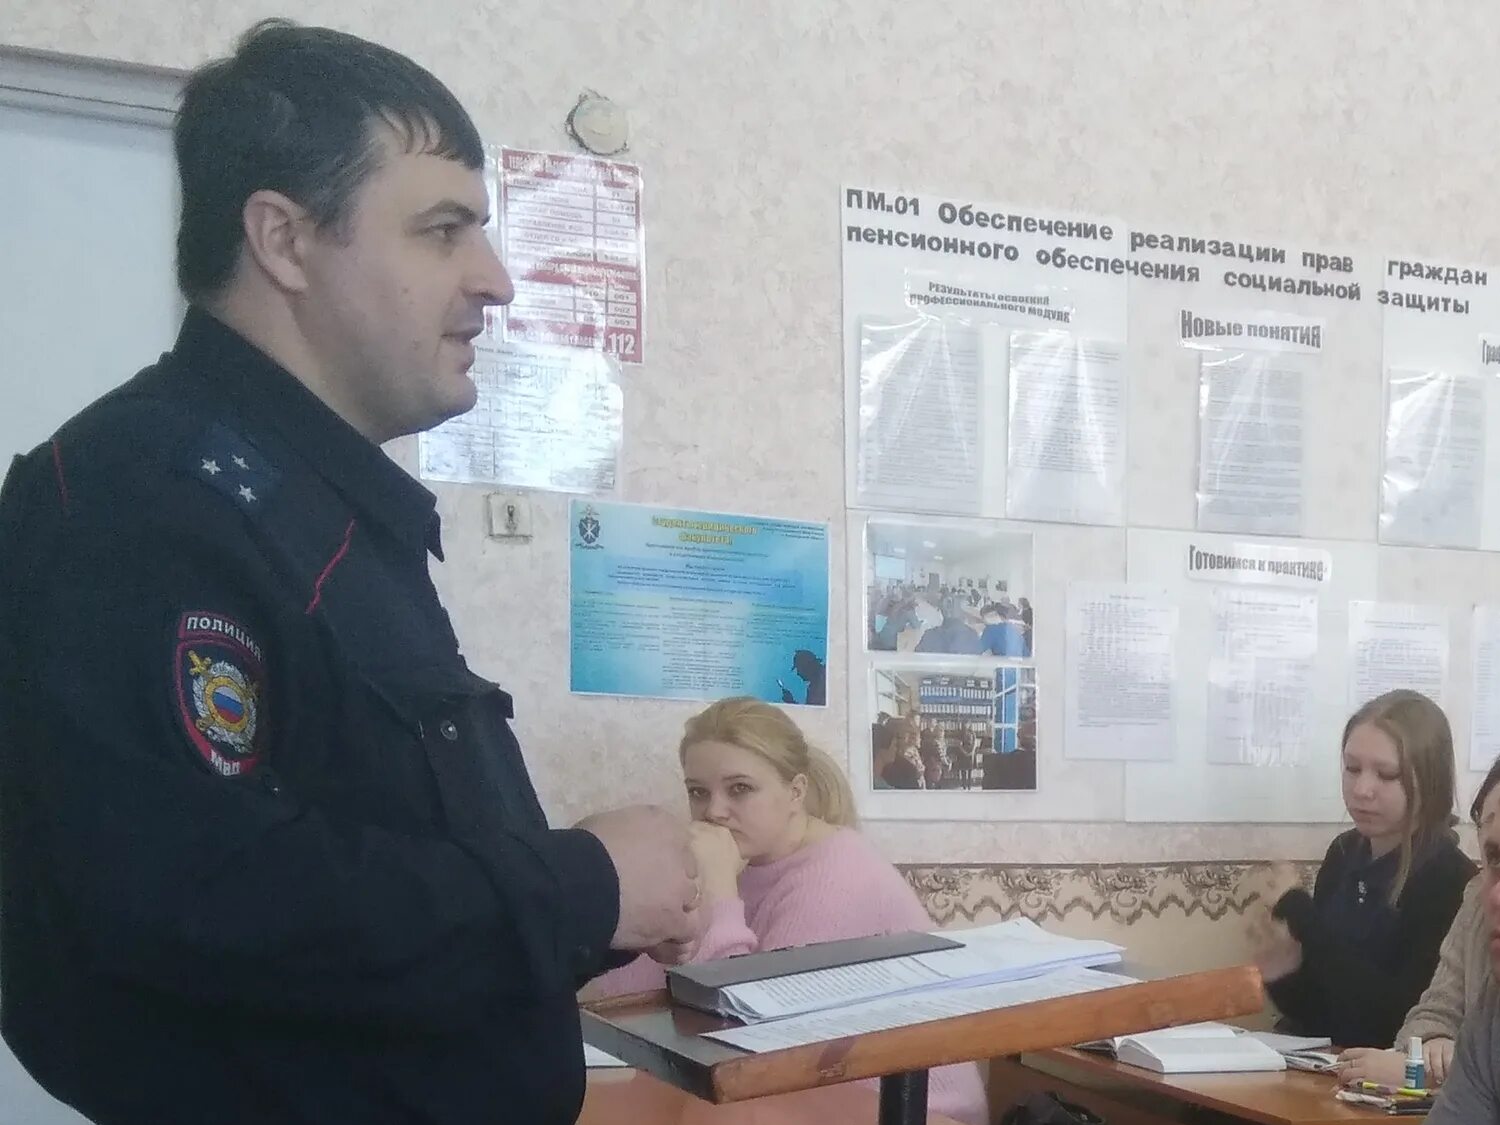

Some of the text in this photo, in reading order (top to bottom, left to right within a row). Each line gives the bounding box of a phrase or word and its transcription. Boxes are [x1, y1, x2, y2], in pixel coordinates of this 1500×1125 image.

[846, 188, 920, 216] ПМ.01
[938, 202, 1114, 240] Обеспечение
[1130, 229, 1286, 265] реализации
[1302, 250, 1354, 273] прав
[1387, 258, 1488, 287] граждан
[847, 225, 1470, 315] пенсионного обеспечения социальной защиты
[608, 332, 635, 355] 112
[1181, 309, 1321, 349] Новые понятия
[1189, 544, 1256, 571] Готовимся
[187, 616, 263, 662] ПОЛИЦИЯ
[210, 749, 241, 777] МВД
